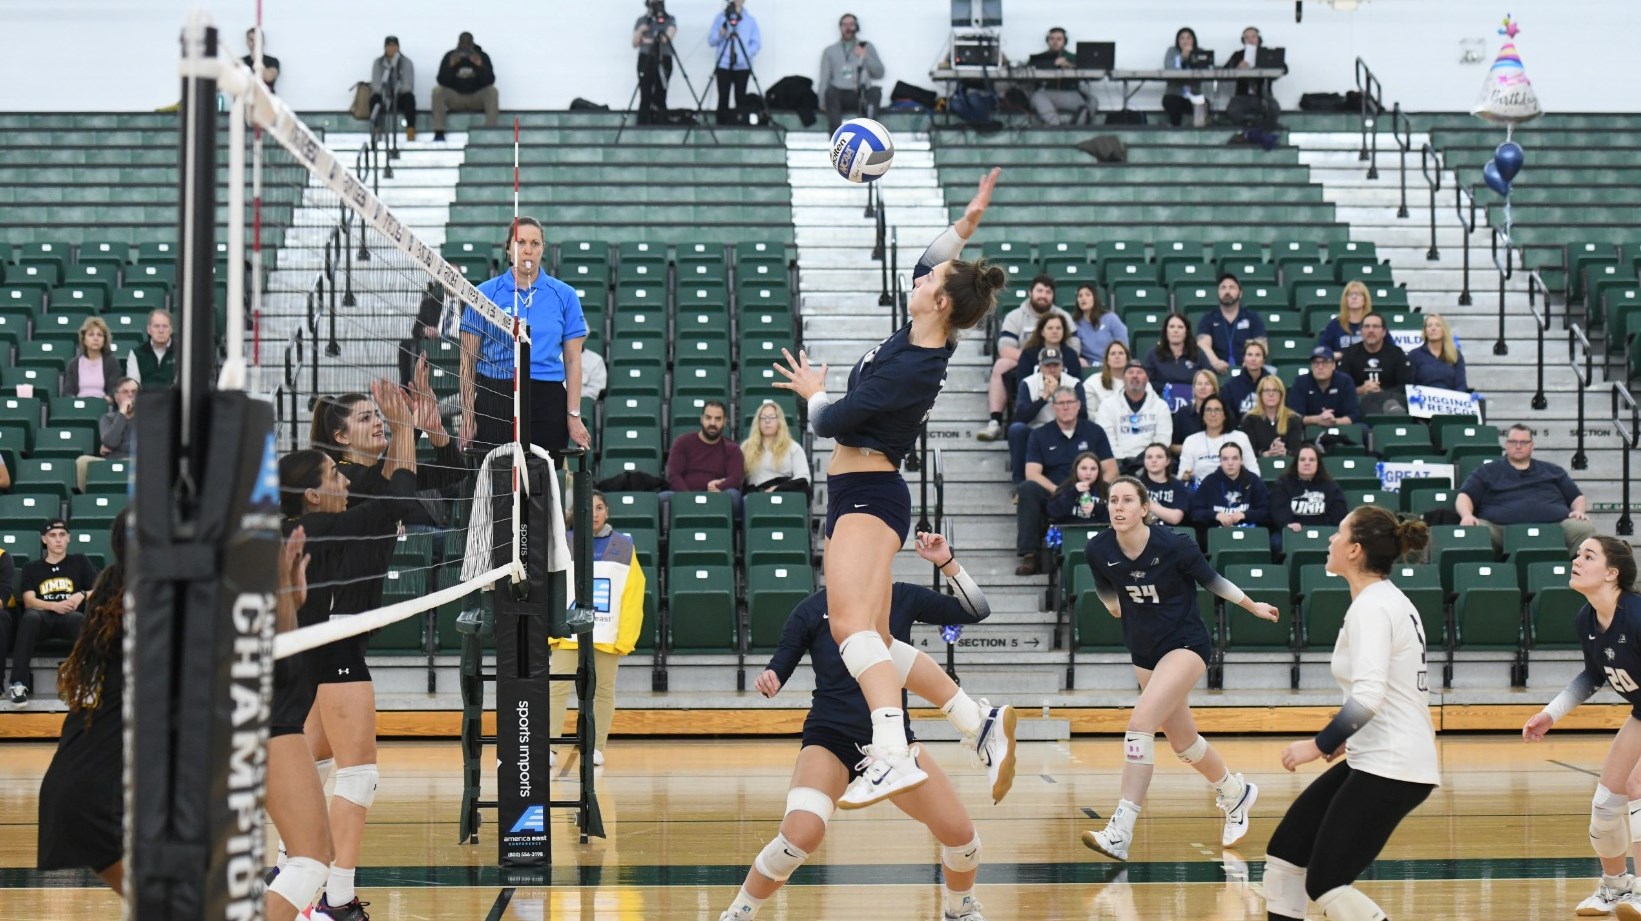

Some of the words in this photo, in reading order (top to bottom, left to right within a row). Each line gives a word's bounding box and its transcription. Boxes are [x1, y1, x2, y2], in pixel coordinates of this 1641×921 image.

[839, 148, 855, 174] NCAA
[925, 430, 960, 439] ECTION
[965, 431, 972, 439] 5
[1543, 429, 1549, 437] 5
[1570, 429, 1611, 437] SCTION
[1385, 470, 1431, 483] GREAT
[1291, 500, 1326, 515] UNH
[520, 523, 528, 556] sports
[39, 577, 74, 595] UMBC
[1125, 584, 1160, 604] 24
[920, 638, 929, 647] 4
[957, 638, 1007, 647] SECTION
[1011, 638, 1018, 647] 5
[1603, 665, 1640, 694] 20
[516, 700, 529, 744] sports
[517, 745, 532, 798] imports
